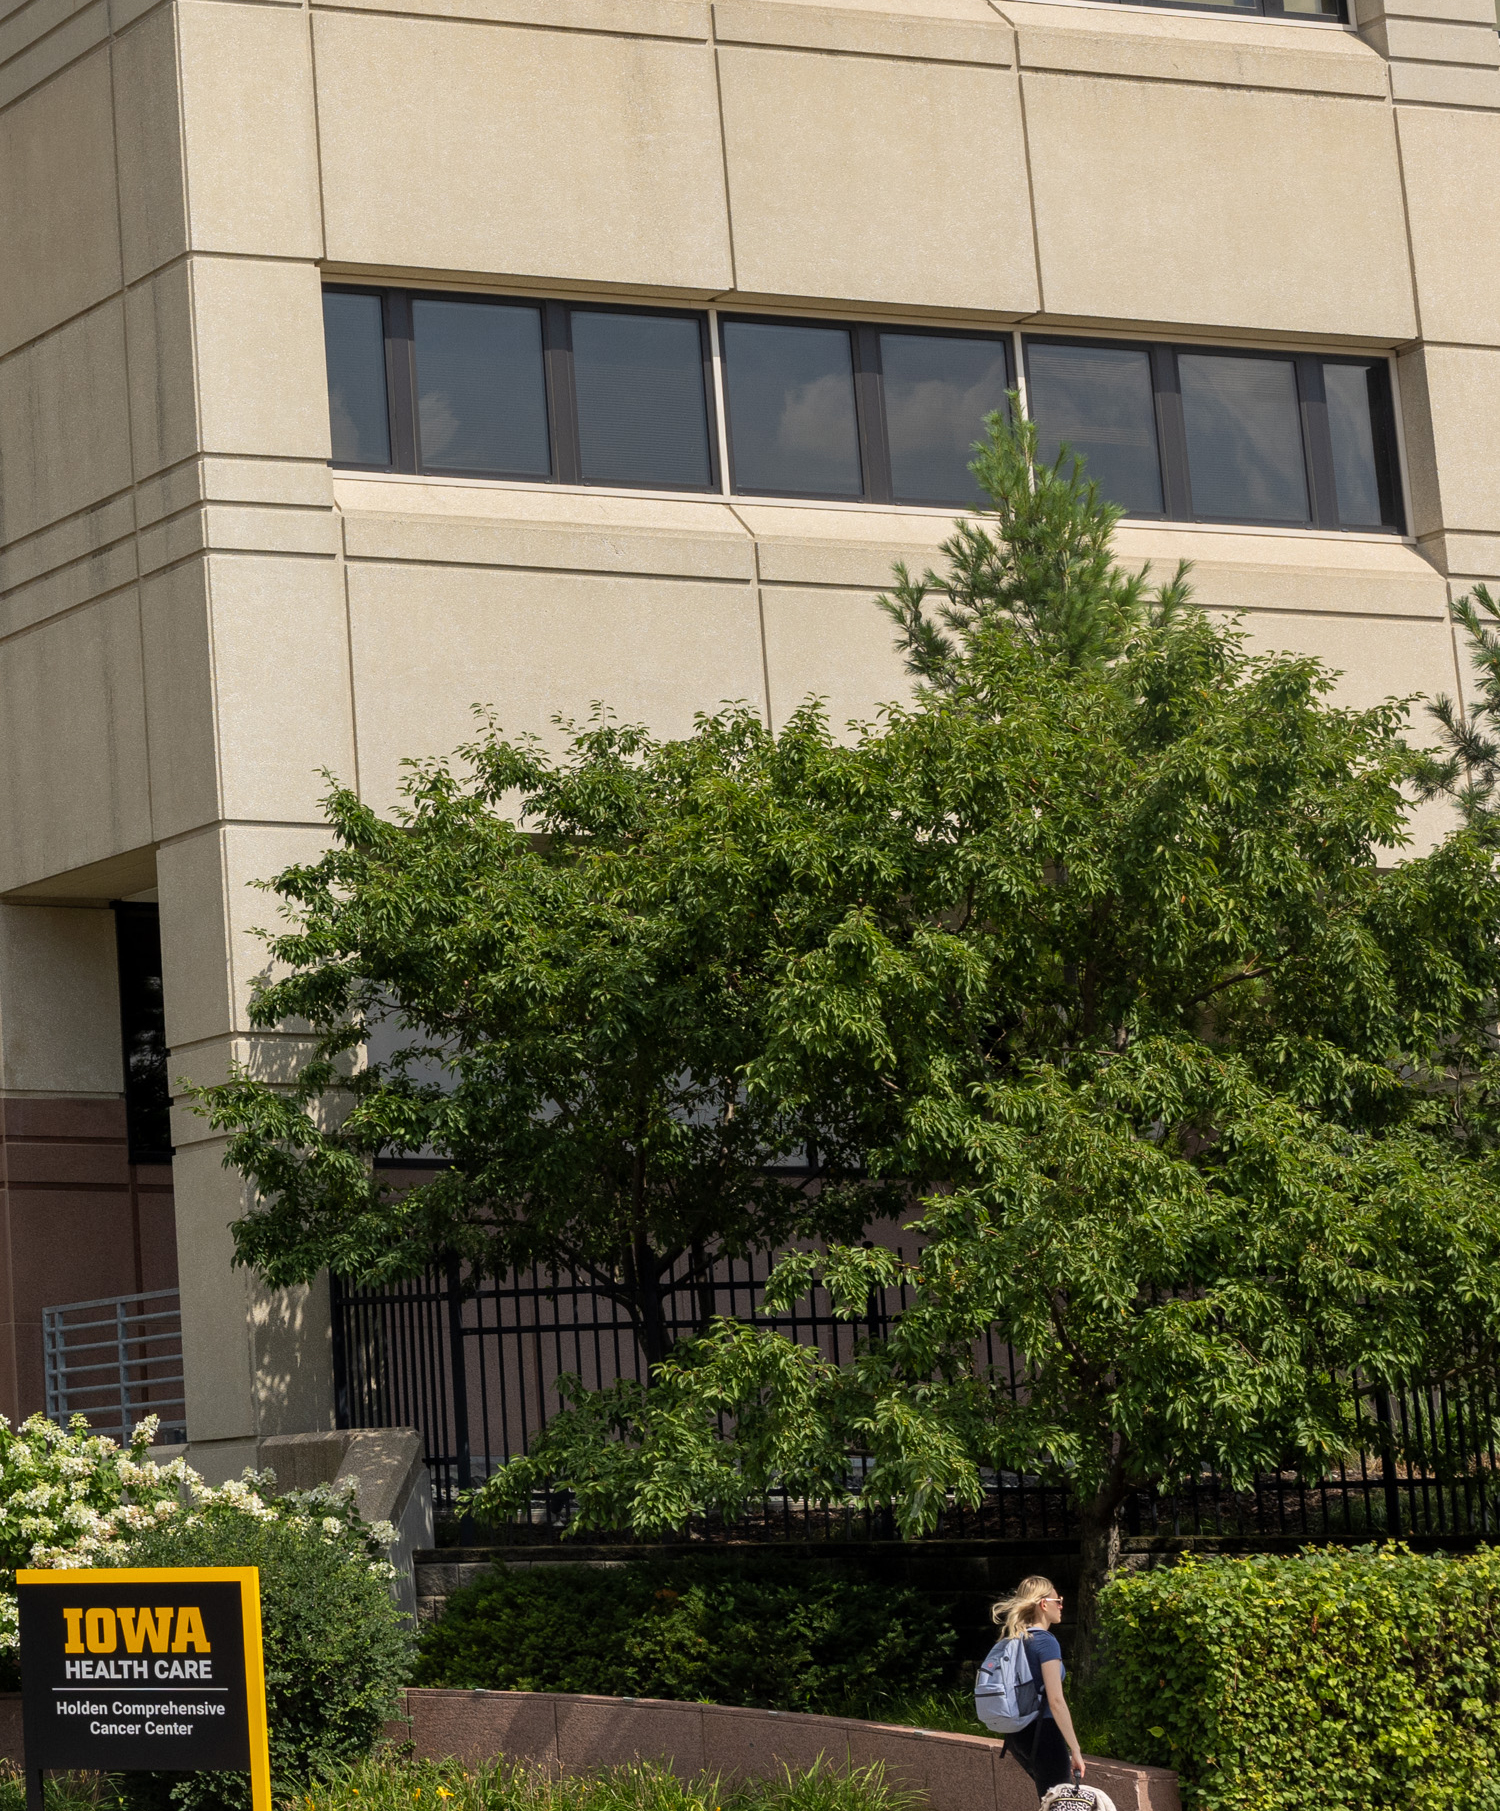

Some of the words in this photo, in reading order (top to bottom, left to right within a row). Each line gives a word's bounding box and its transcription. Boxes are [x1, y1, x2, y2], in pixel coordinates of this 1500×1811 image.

[63, 1607, 211, 1653] IOWA
[65, 1660, 148, 1679] HEALTH
[154, 1660, 213, 1679] CARE
[56, 1701, 108, 1715] Holden
[112, 1701, 226, 1718] Comprehensive
[90, 1721, 141, 1735] Cancer
[144, 1721, 194, 1735] Center
